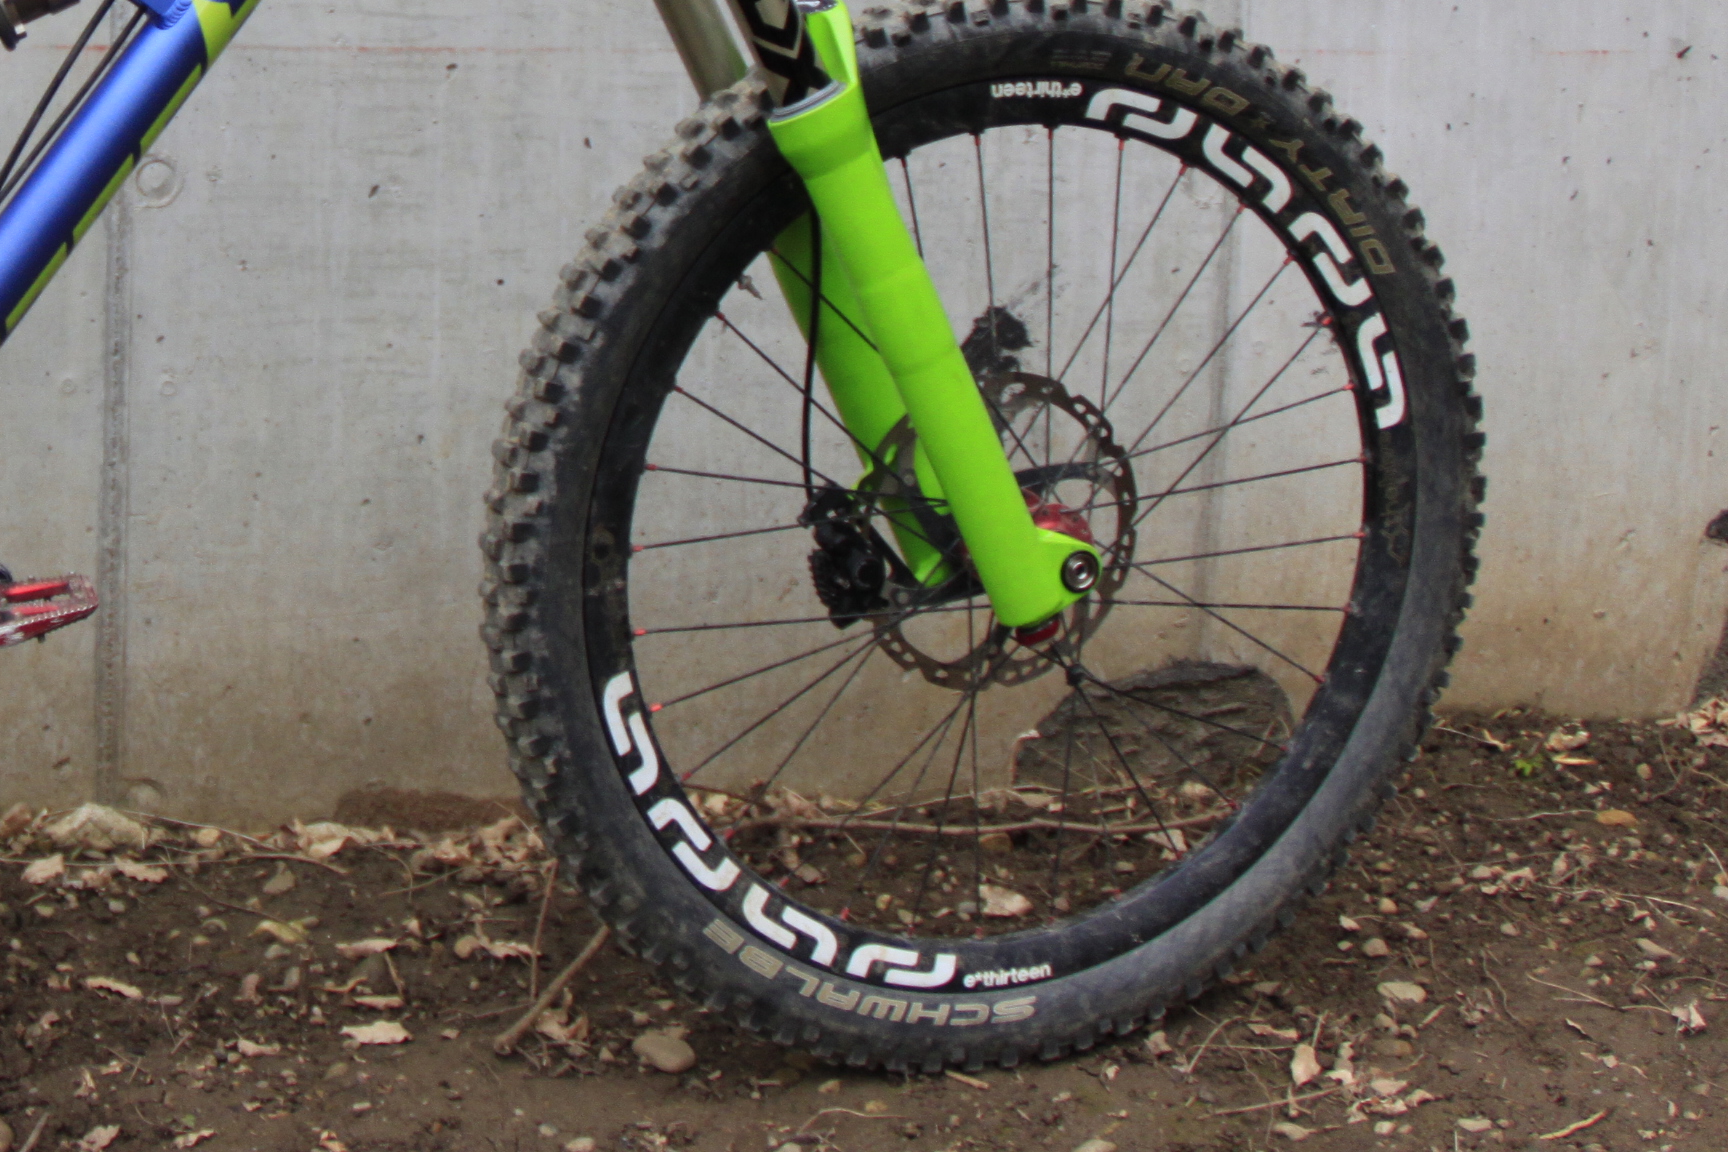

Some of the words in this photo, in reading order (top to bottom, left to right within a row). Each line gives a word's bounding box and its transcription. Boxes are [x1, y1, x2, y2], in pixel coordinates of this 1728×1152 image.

[1122, 51, 1251, 116] DAN
[1268, 139, 1396, 275] DIRTY
[702, 918, 1038, 1027] SCHWALBE
